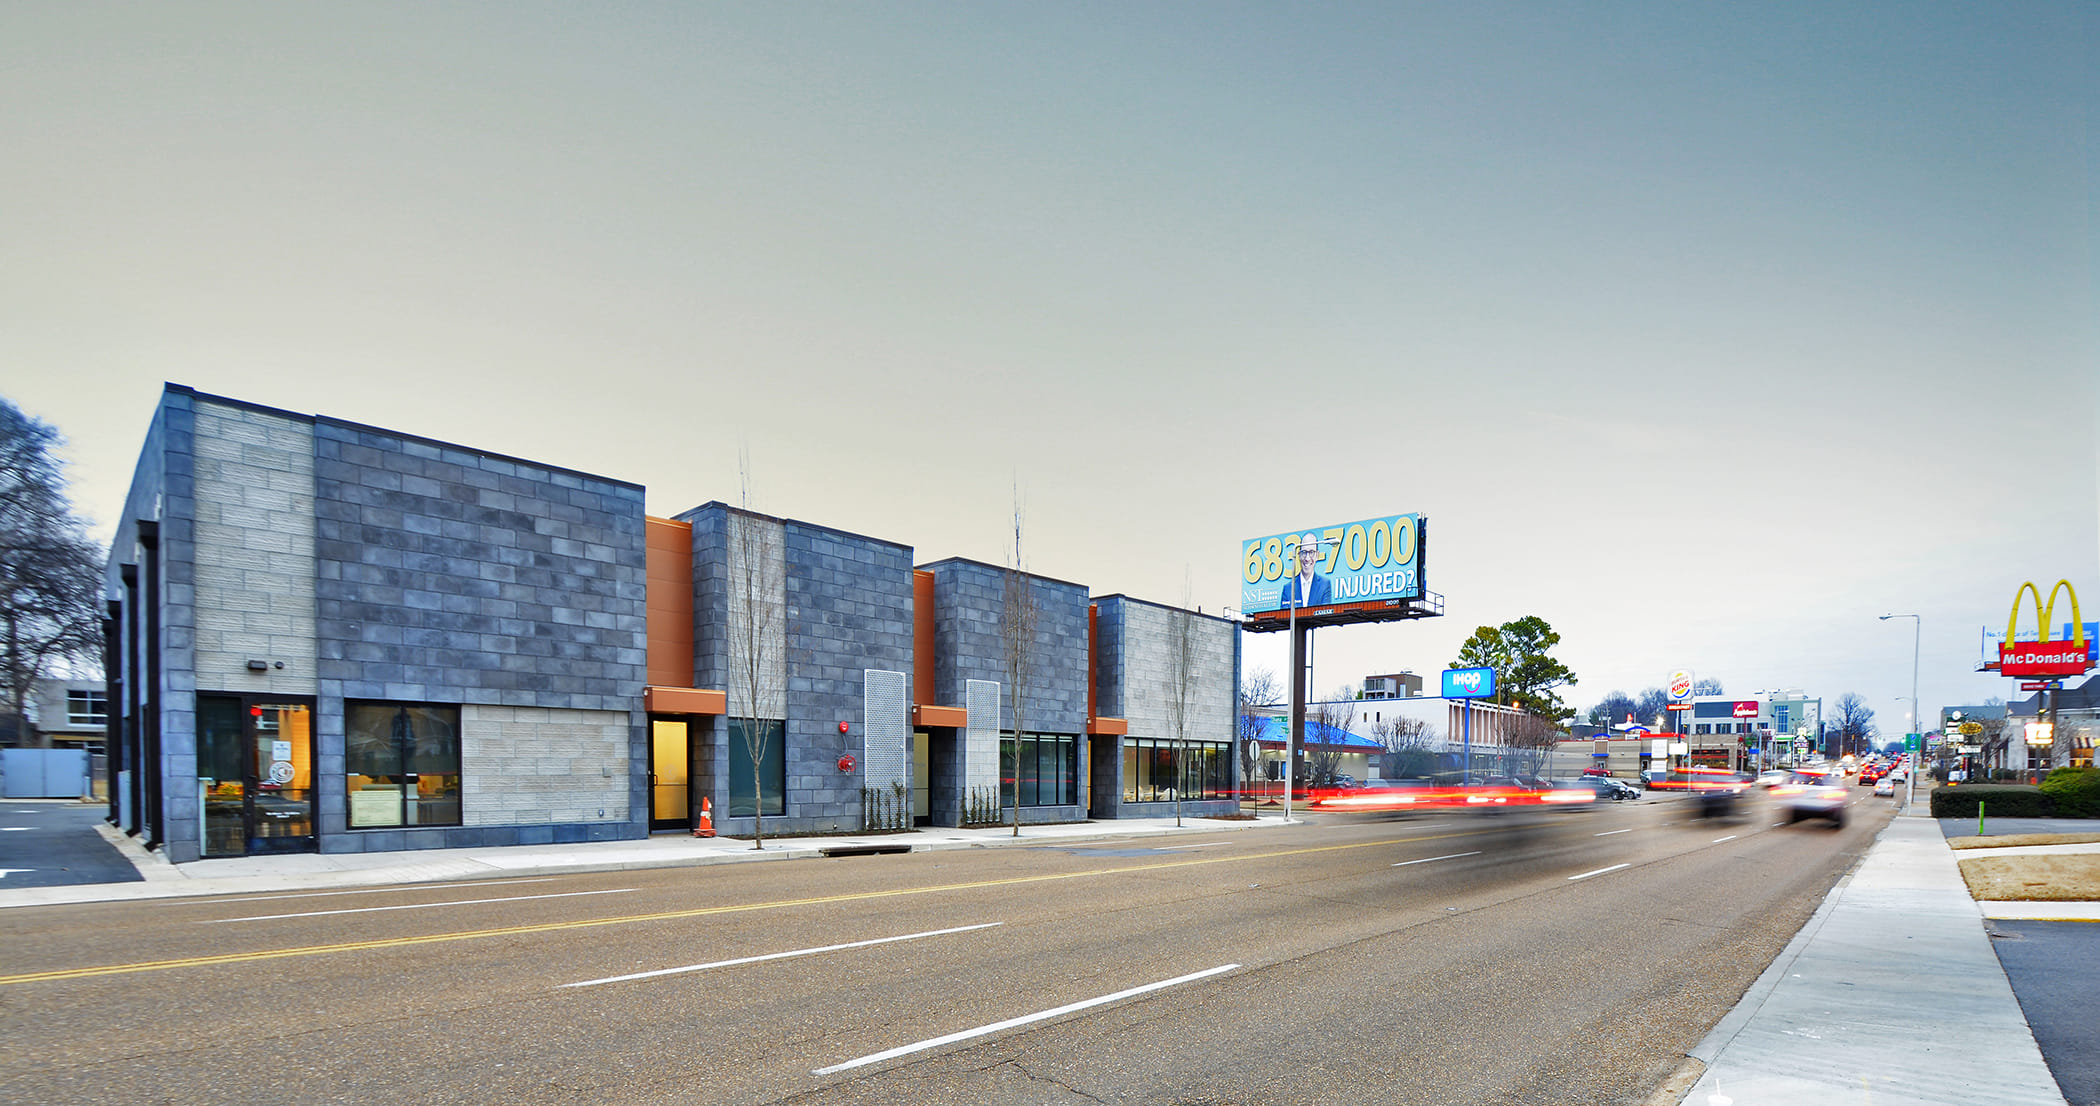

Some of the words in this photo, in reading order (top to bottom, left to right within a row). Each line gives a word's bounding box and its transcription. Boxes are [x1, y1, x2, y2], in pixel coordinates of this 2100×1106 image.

[1334, 569, 1415, 600] INJURED?
[2003, 652, 2085, 665] McDonald's
[1671, 680, 1690, 693] KING
